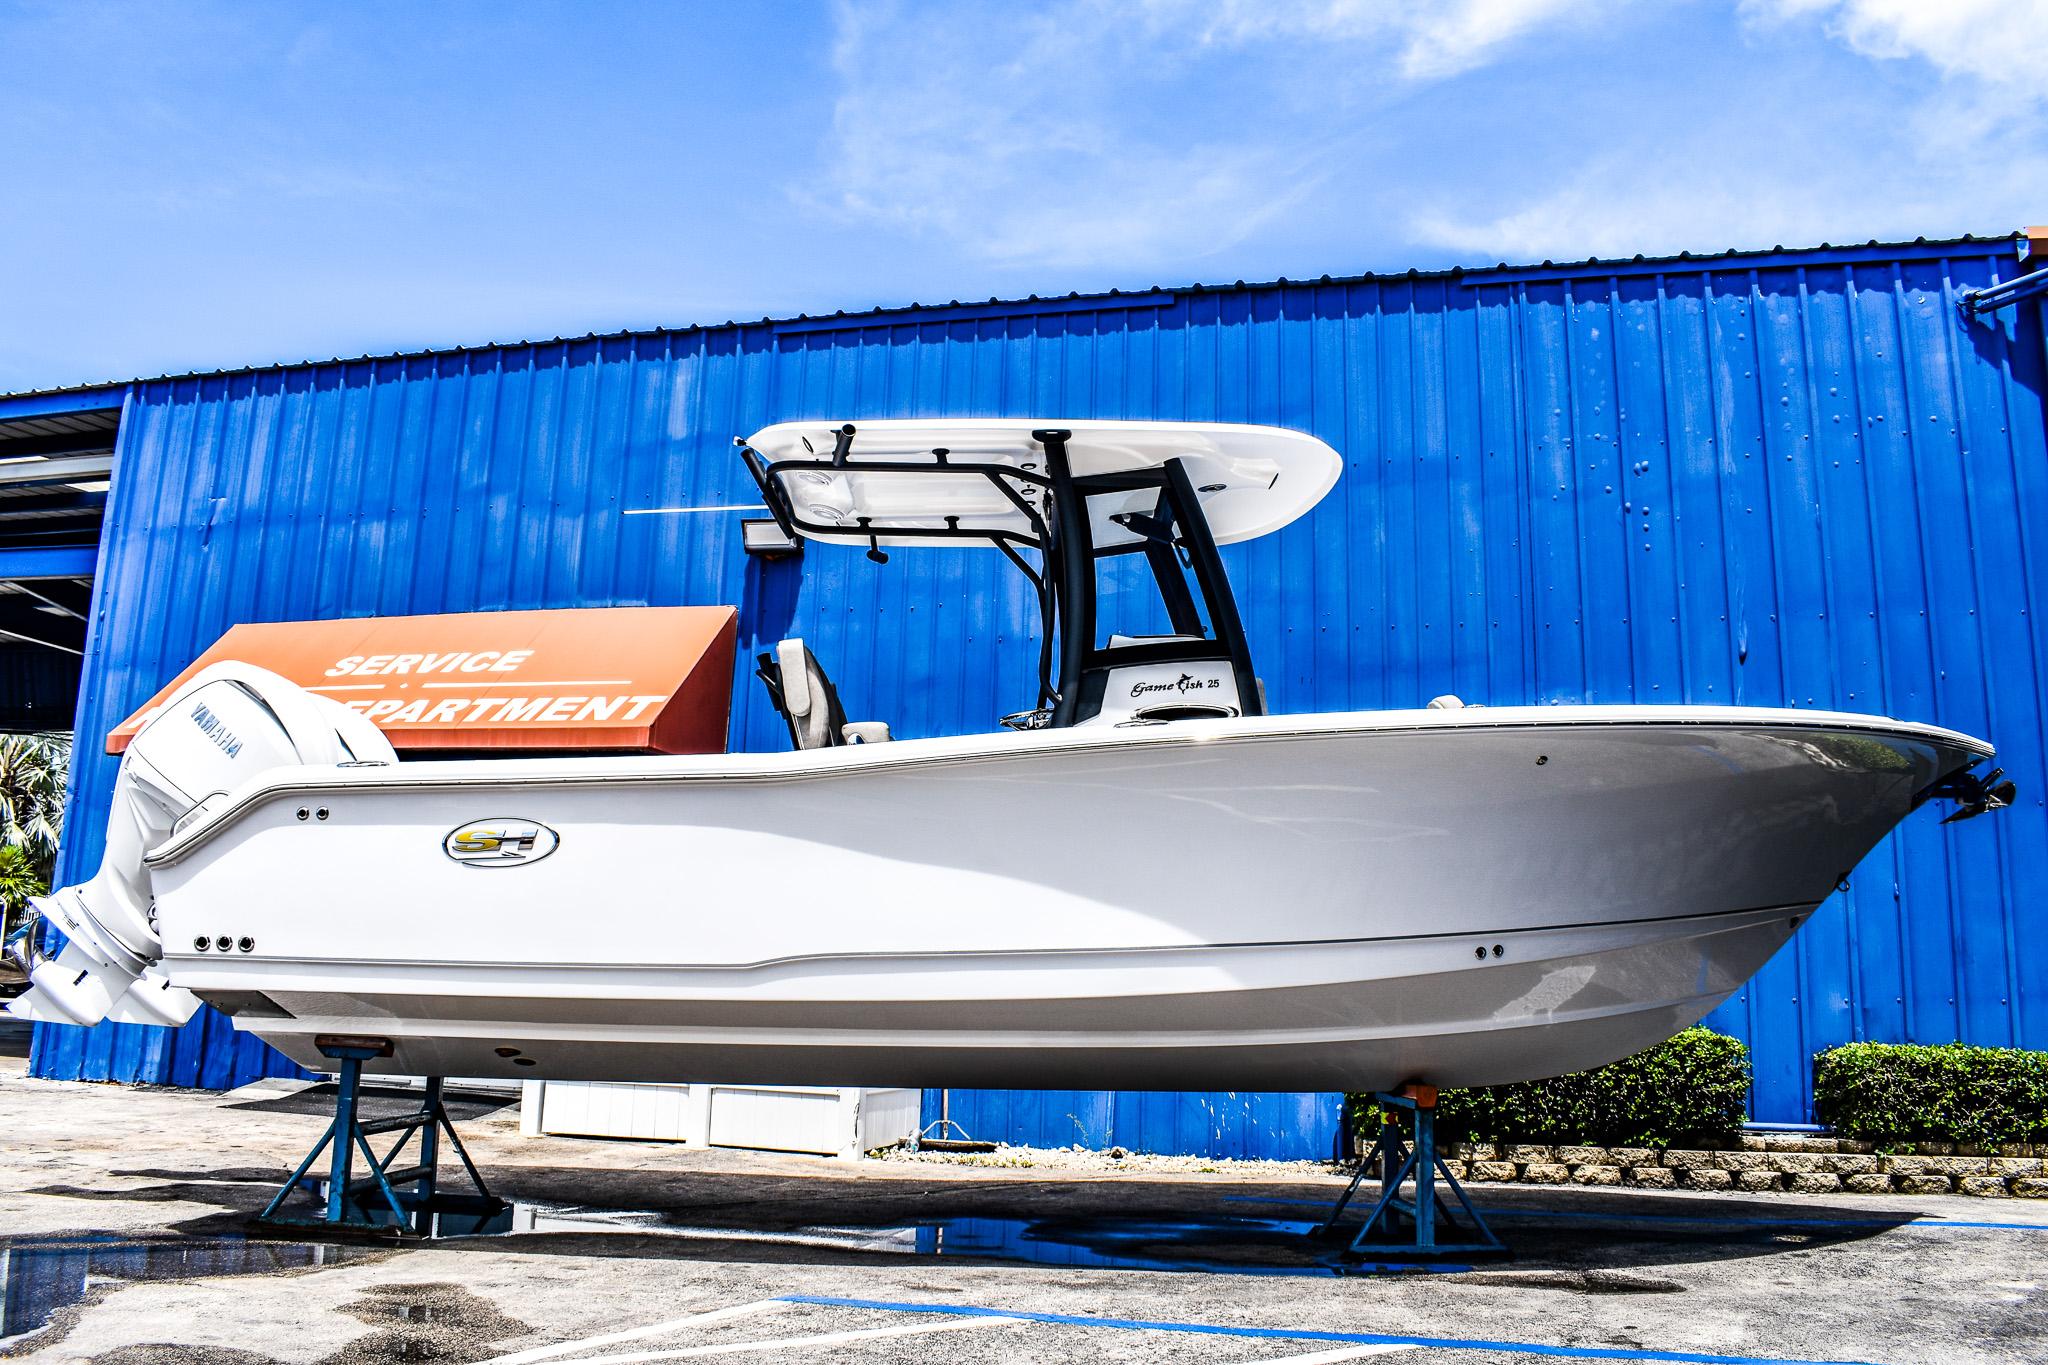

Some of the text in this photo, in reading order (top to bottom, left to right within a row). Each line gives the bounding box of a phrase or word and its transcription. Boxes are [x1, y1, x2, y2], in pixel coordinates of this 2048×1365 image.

[324, 650, 535, 677] SERVICE
[1207, 679, 1221, 689] 25
[345, 695, 669, 723] EPARTMENT
[190, 702, 243, 759] YAMAHA
